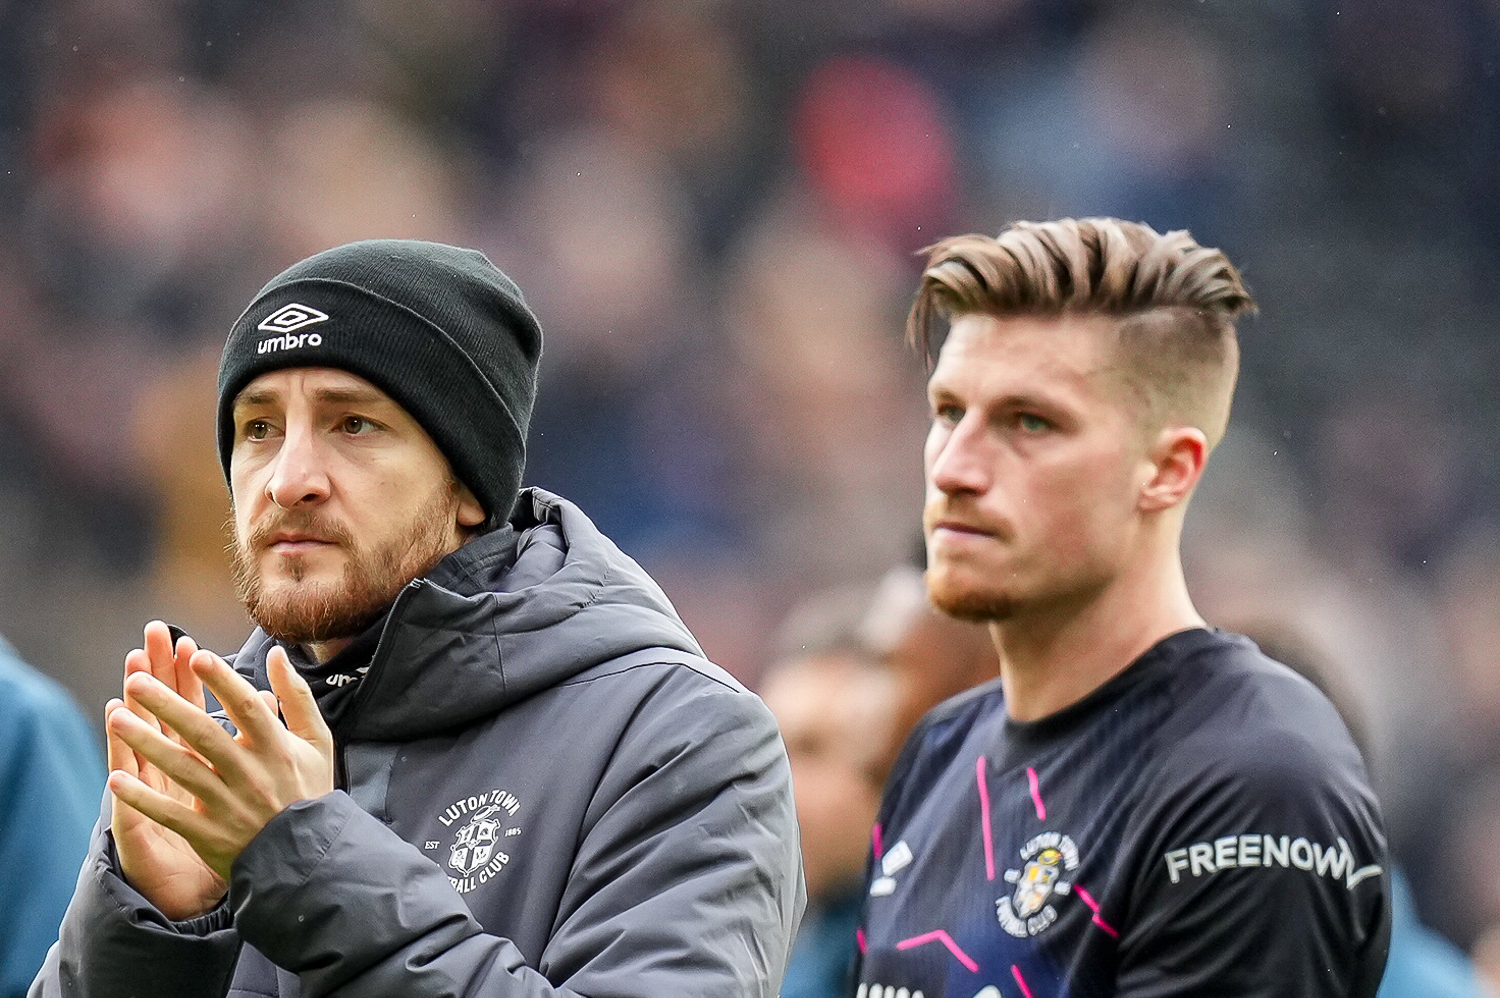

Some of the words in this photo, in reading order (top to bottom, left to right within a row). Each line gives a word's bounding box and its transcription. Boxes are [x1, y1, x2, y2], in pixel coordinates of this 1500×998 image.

[257, 333, 323, 354] umbro
[438, 793, 488, 827] LUTON
[488, 789, 521, 817] TOWN
[424, 840, 441, 850] EST
[447, 874, 477, 894] BALL
[479, 851, 510, 884] CLUB
